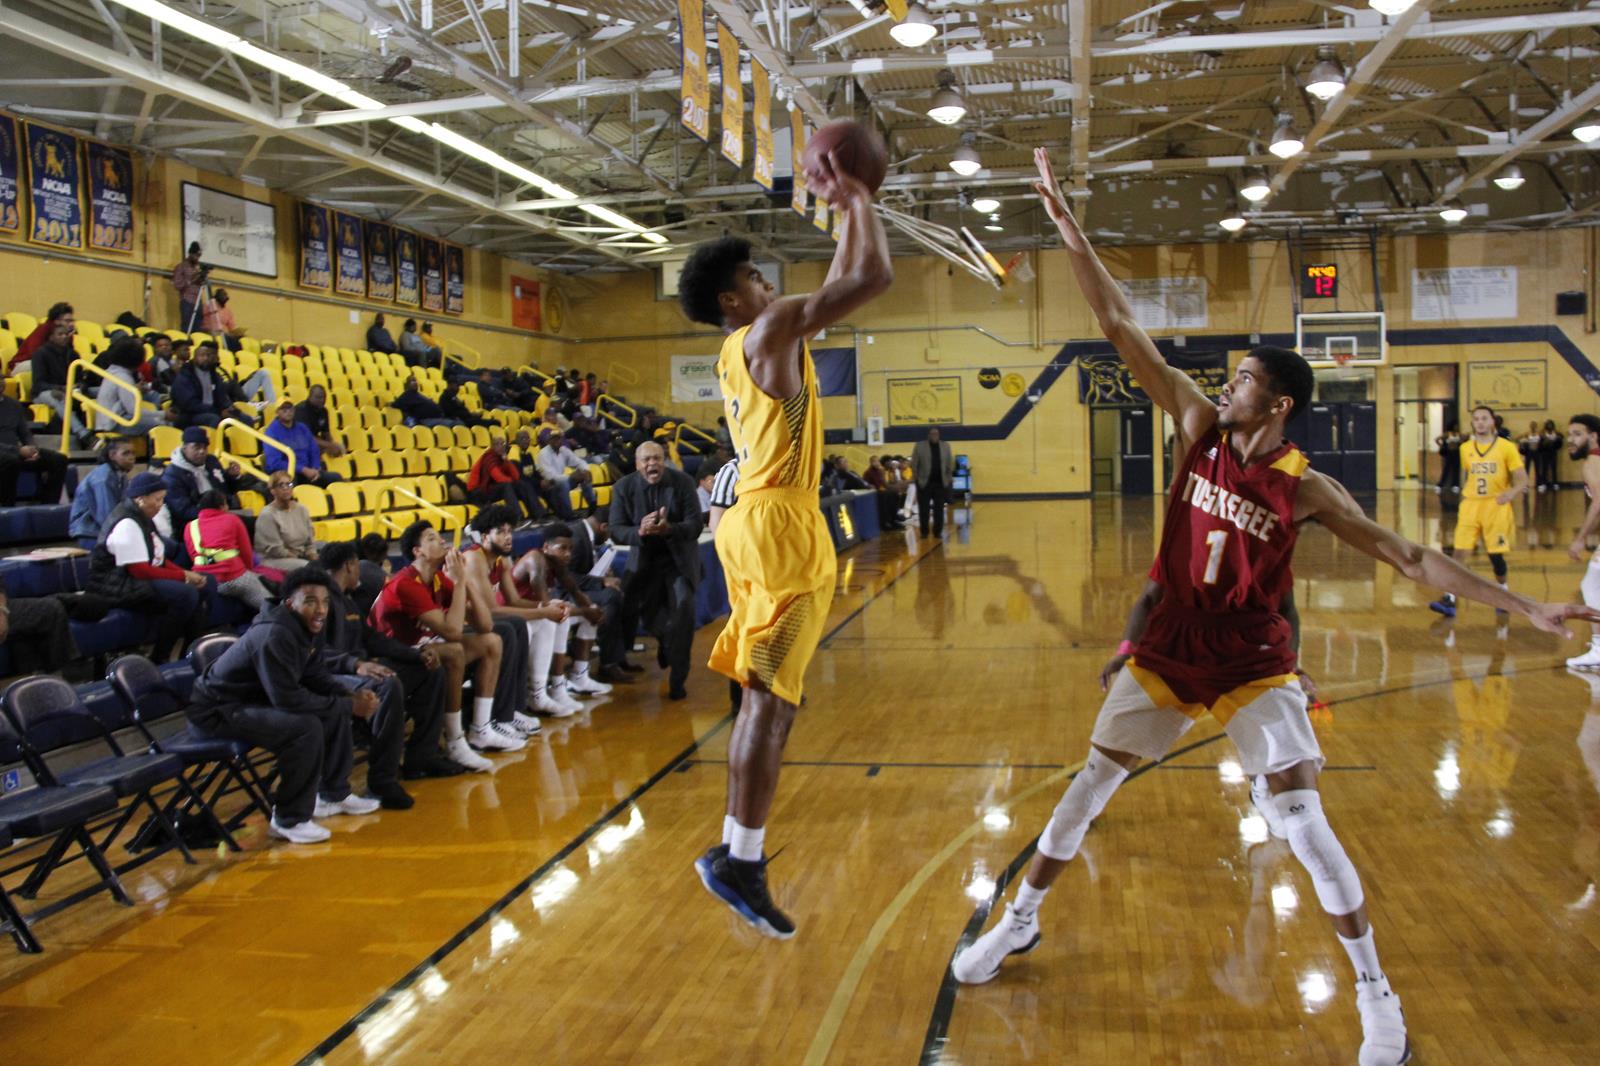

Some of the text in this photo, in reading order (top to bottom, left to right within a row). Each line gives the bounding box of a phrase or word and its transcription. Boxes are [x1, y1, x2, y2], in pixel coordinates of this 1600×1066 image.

[41, 177, 72, 196] NCAA
[102, 188, 127, 204] NCAA
[36, 216, 81, 248] 2011
[1477, 478, 1488, 495] 2
[1181, 471, 1281, 543] TUSKEGEE
[1202, 529, 1229, 585] 1
